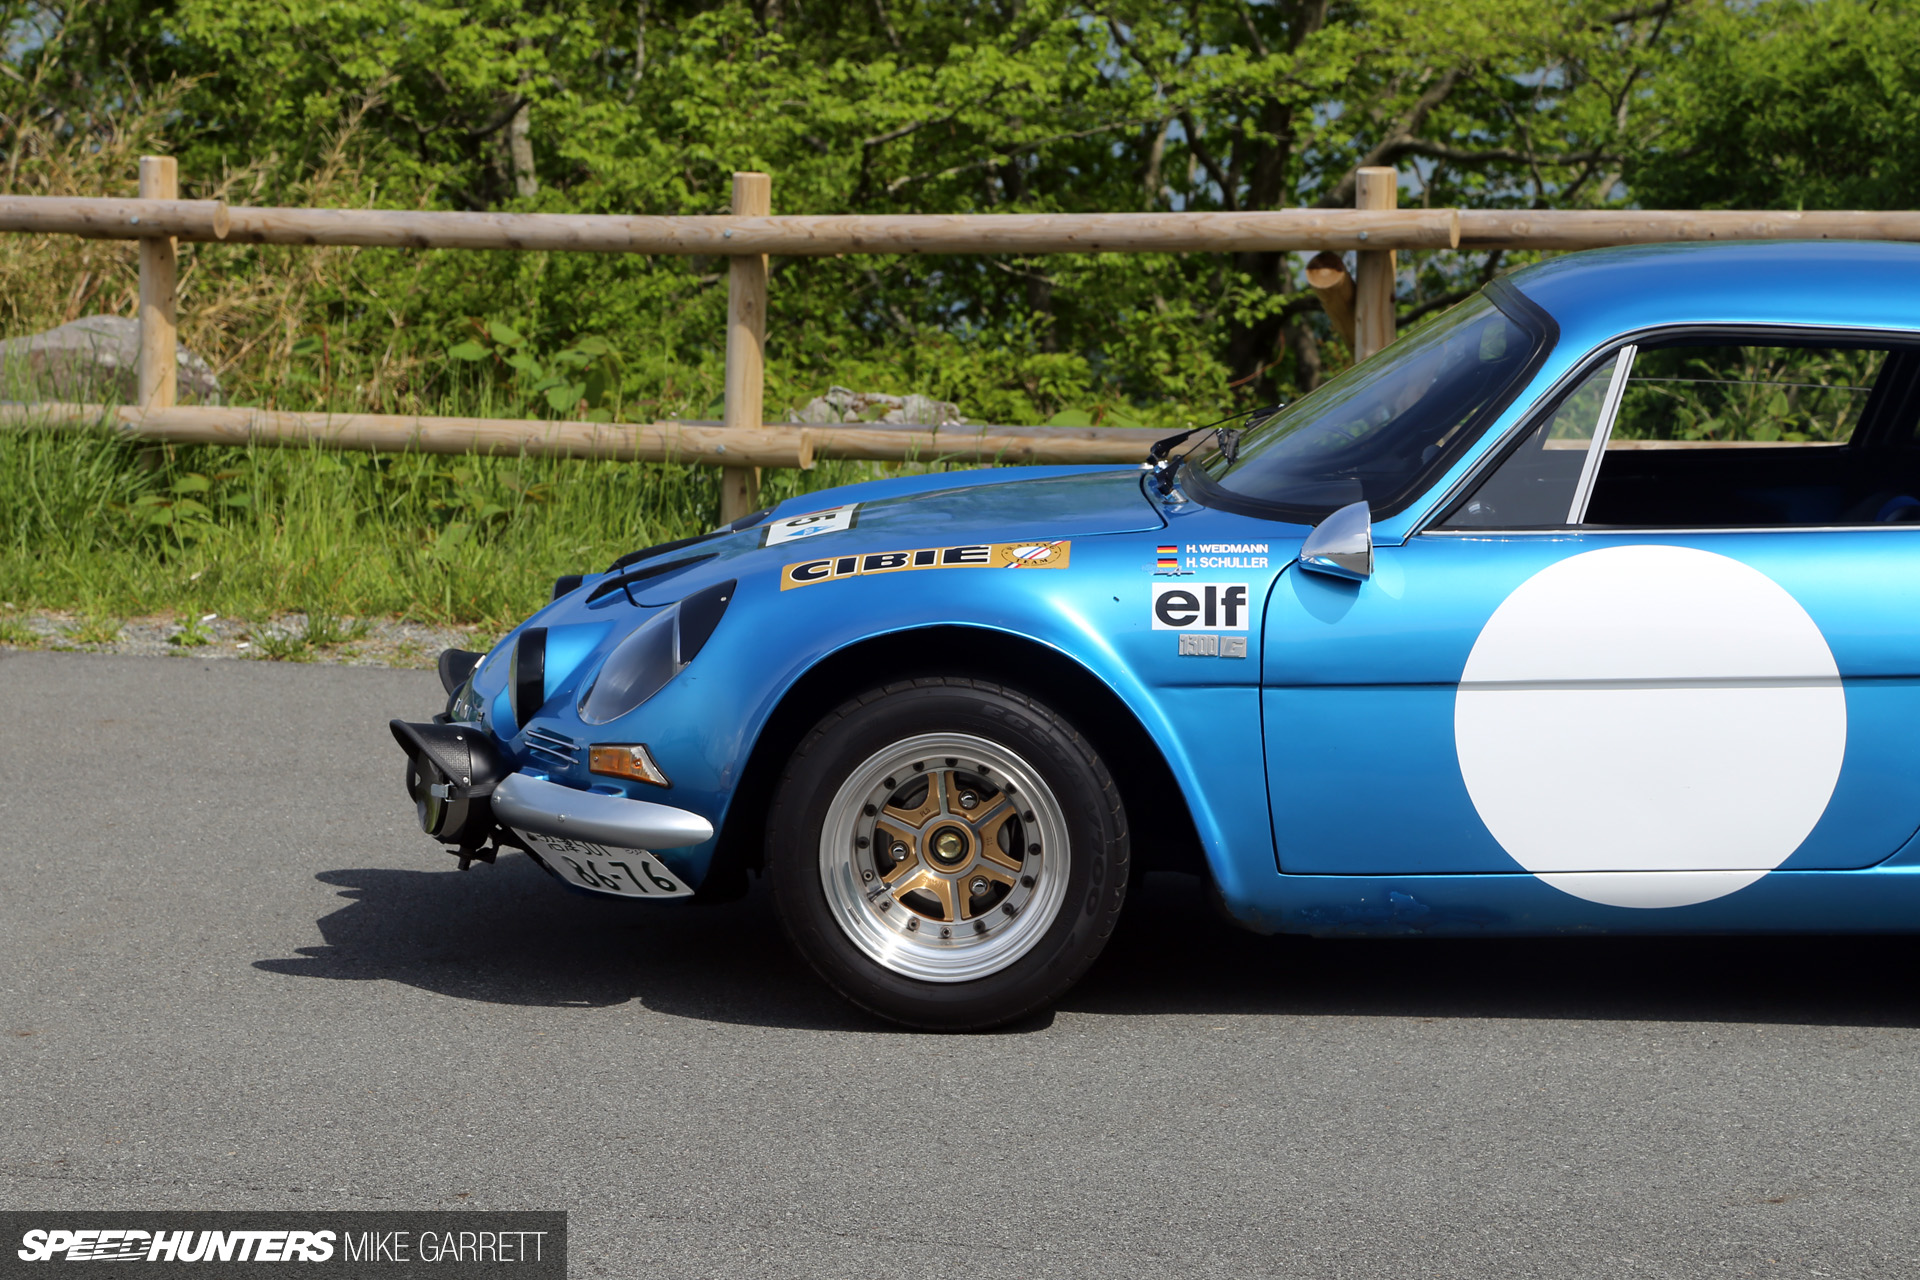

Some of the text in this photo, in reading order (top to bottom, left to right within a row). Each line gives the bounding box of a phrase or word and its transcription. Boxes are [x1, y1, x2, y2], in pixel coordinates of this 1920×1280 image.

[1199, 544, 1268, 553] WEIDMANN
[1200, 557, 1268, 568] SCHULLER
[1155, 586, 1246, 627] elf
[560, 855, 677, 893] 86-76
